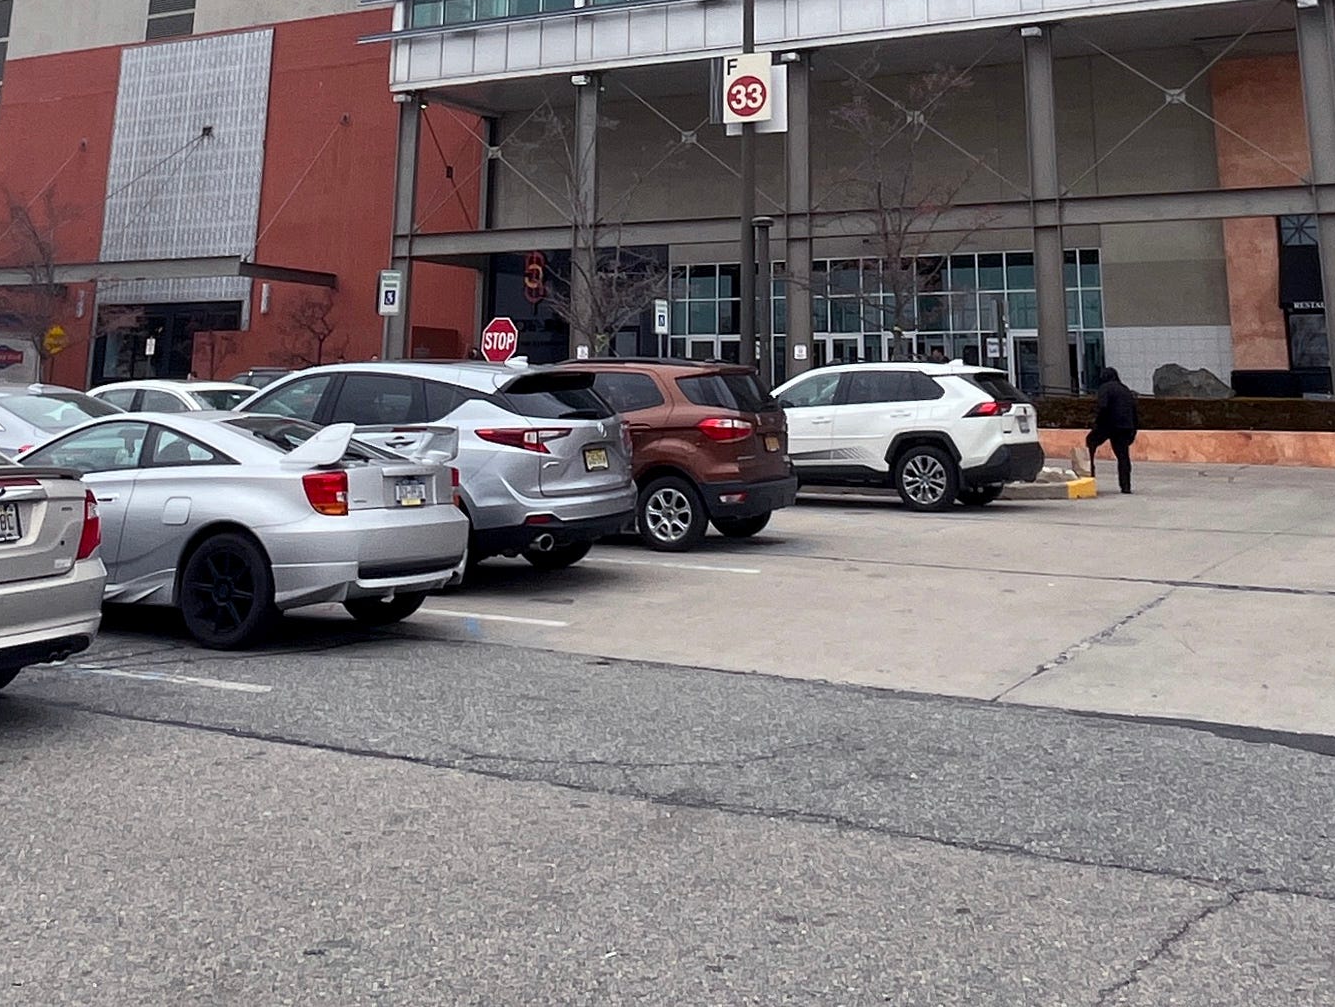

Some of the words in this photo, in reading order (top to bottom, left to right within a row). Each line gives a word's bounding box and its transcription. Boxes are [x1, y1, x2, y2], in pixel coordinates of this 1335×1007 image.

[727, 58, 738, 76] F
[730, 82, 763, 110] 33
[484, 332, 516, 350] STOP
